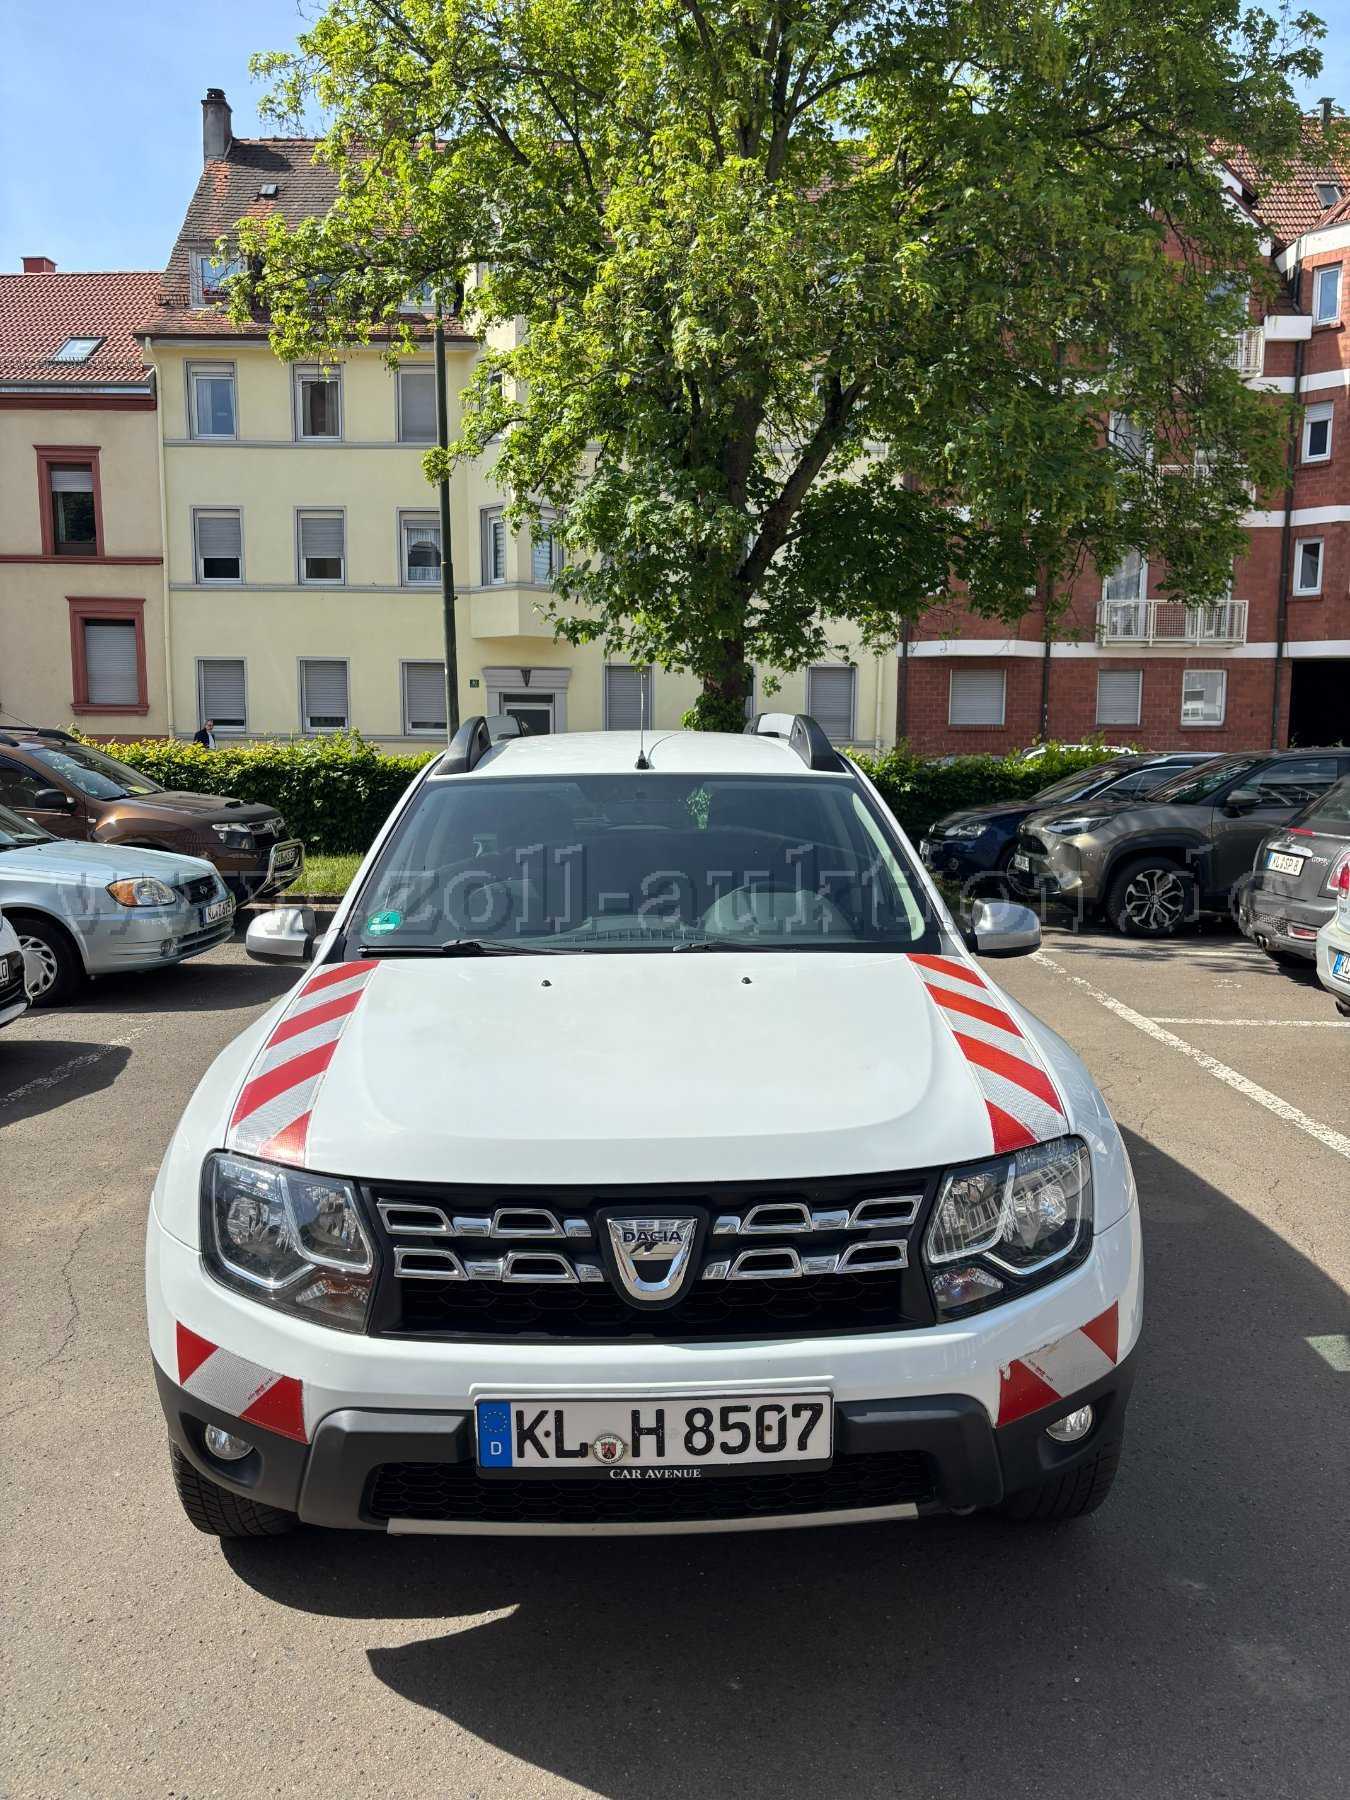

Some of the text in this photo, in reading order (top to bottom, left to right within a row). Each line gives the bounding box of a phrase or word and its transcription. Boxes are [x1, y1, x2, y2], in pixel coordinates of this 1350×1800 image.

[623, 1231, 682, 1242] DACIA
[631, 1408, 666, 1457] H
[684, 1403, 824, 1456] 8507
[490, 1441, 502, 1455] D
[609, 1468, 702, 1479] CAR AVENUE
